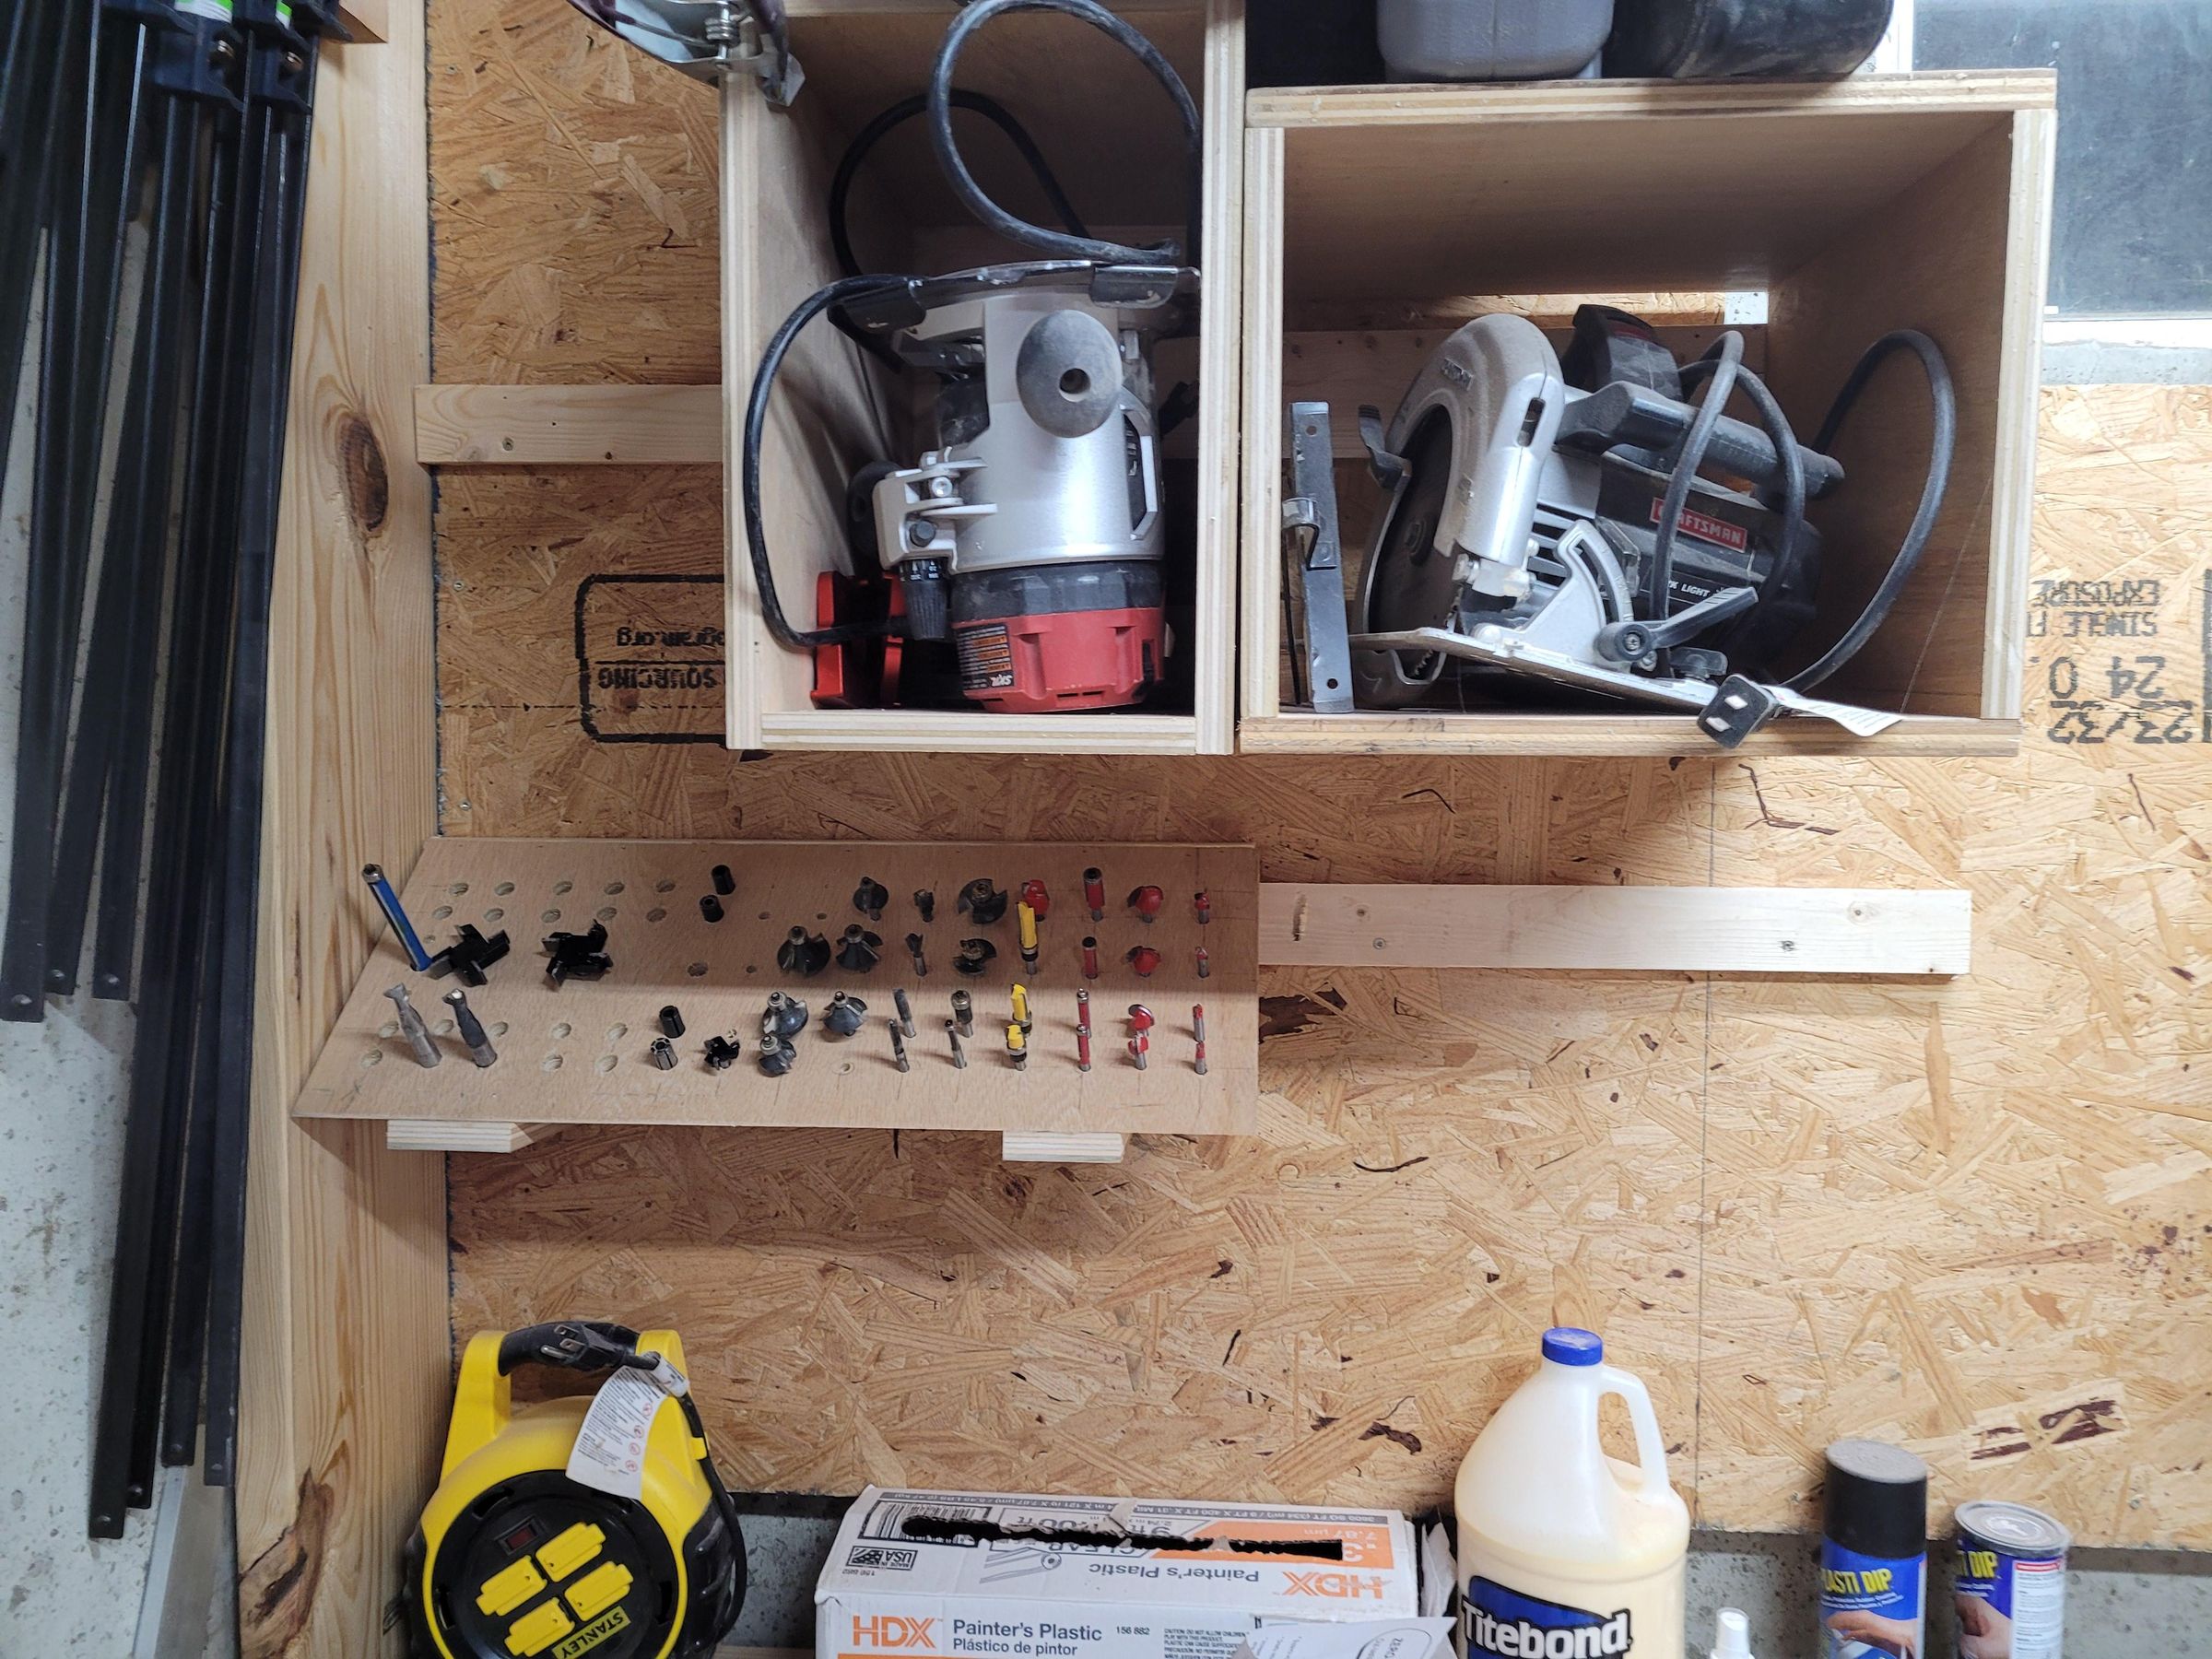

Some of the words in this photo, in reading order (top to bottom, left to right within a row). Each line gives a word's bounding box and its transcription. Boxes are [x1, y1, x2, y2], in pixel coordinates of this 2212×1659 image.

[1658, 505, 1741, 544] AFTSMAN
[1681, 583, 1711, 597] LIGHT
[598, 668, 718, 689] SOURCING
[2105, 655, 2166, 699] 24
[886, 1550, 912, 1563] USA
[1088, 1561, 1159, 1578] Plastic
[1166, 1566, 1259, 1583] Painter's
[1282, 1571, 1384, 1599] HDX
[1860, 1568, 1892, 1594] DIP
[559, 1611, 625, 1659] STANLEY
[853, 1616, 936, 1648] HDX
[953, 1618, 1033, 1638] Painter's
[1040, 1623, 1102, 1641] Plastic
[1461, 1599, 1630, 1659] Titebond
[953, 1638, 1009, 1653] Plástico
[1013, 1639, 1031, 1654] de
[1035, 1641, 1077, 1657] pintor
